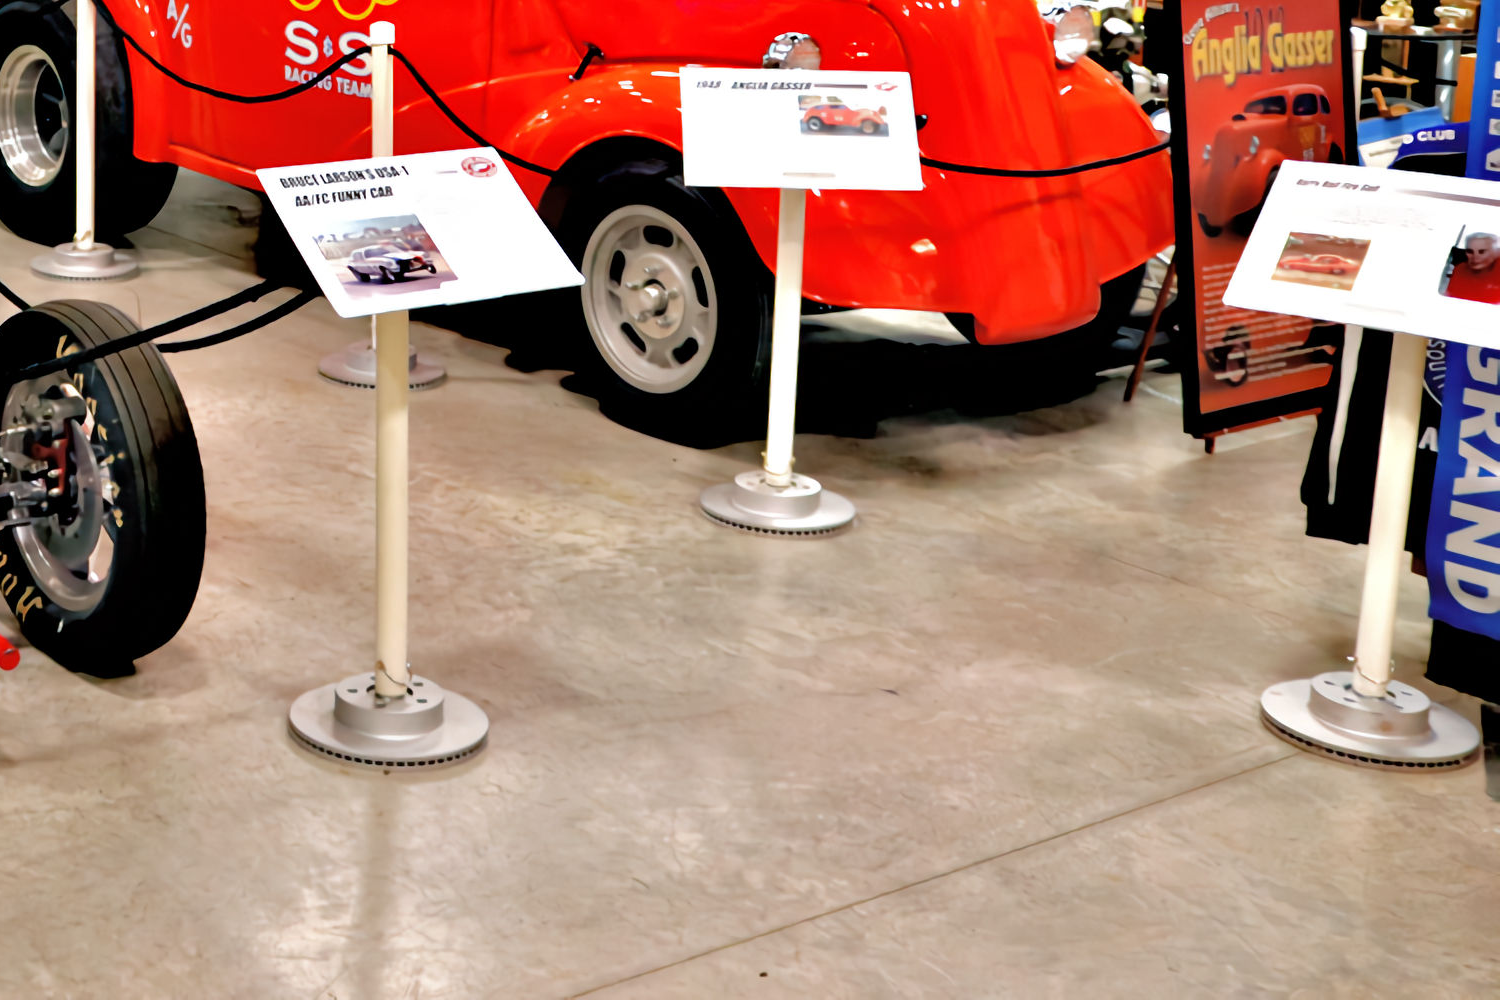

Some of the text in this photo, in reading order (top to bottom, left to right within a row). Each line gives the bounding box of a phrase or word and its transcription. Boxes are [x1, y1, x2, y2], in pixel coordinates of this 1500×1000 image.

[1192, 24, 1262, 88] Anglia
[1267, 21, 1334, 70] Gasser
[284, 64, 333, 91] RACING
[731, 81, 768, 90] ANGLIA
[770, 81, 812, 90] GASSER
[1416, 129, 1456, 142] CLUB
[280, 174, 320, 189] BRUCE
[320, 168, 376, 185] LARSON'S
[332, 190, 368, 204] FUNNY
[370, 186, 394, 199] CAR
